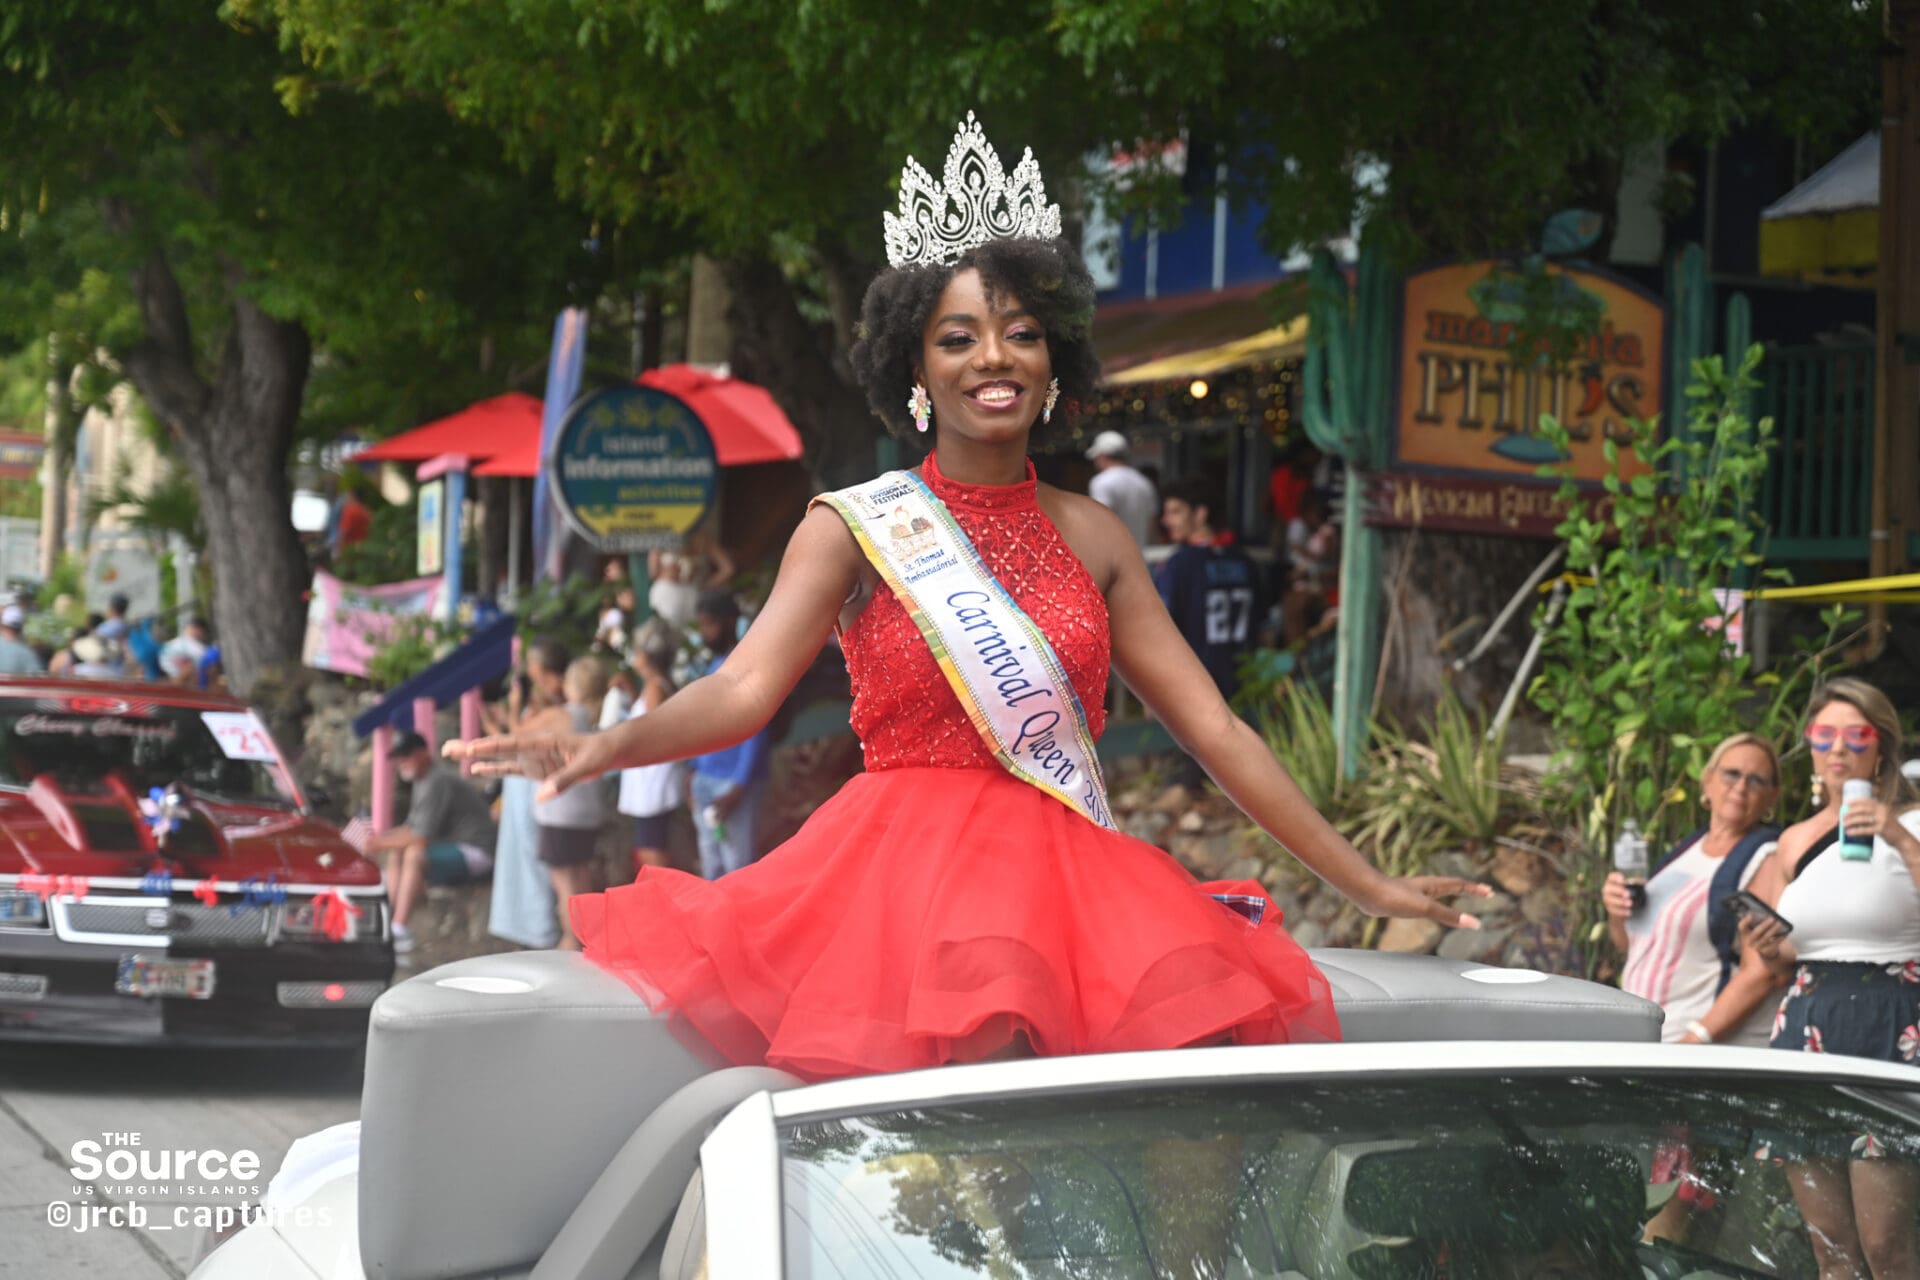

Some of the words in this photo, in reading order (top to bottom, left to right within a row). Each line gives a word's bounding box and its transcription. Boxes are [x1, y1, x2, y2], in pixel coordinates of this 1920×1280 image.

[1425, 309, 1645, 367] marita
[873, 488, 915, 505] FESTIVALS
[904, 554, 959, 585] Ambassadorial
[915, 549, 945, 566] Thomas
[946, 591, 1052, 708] Carnival
[1012, 711, 1076, 785] Queen
